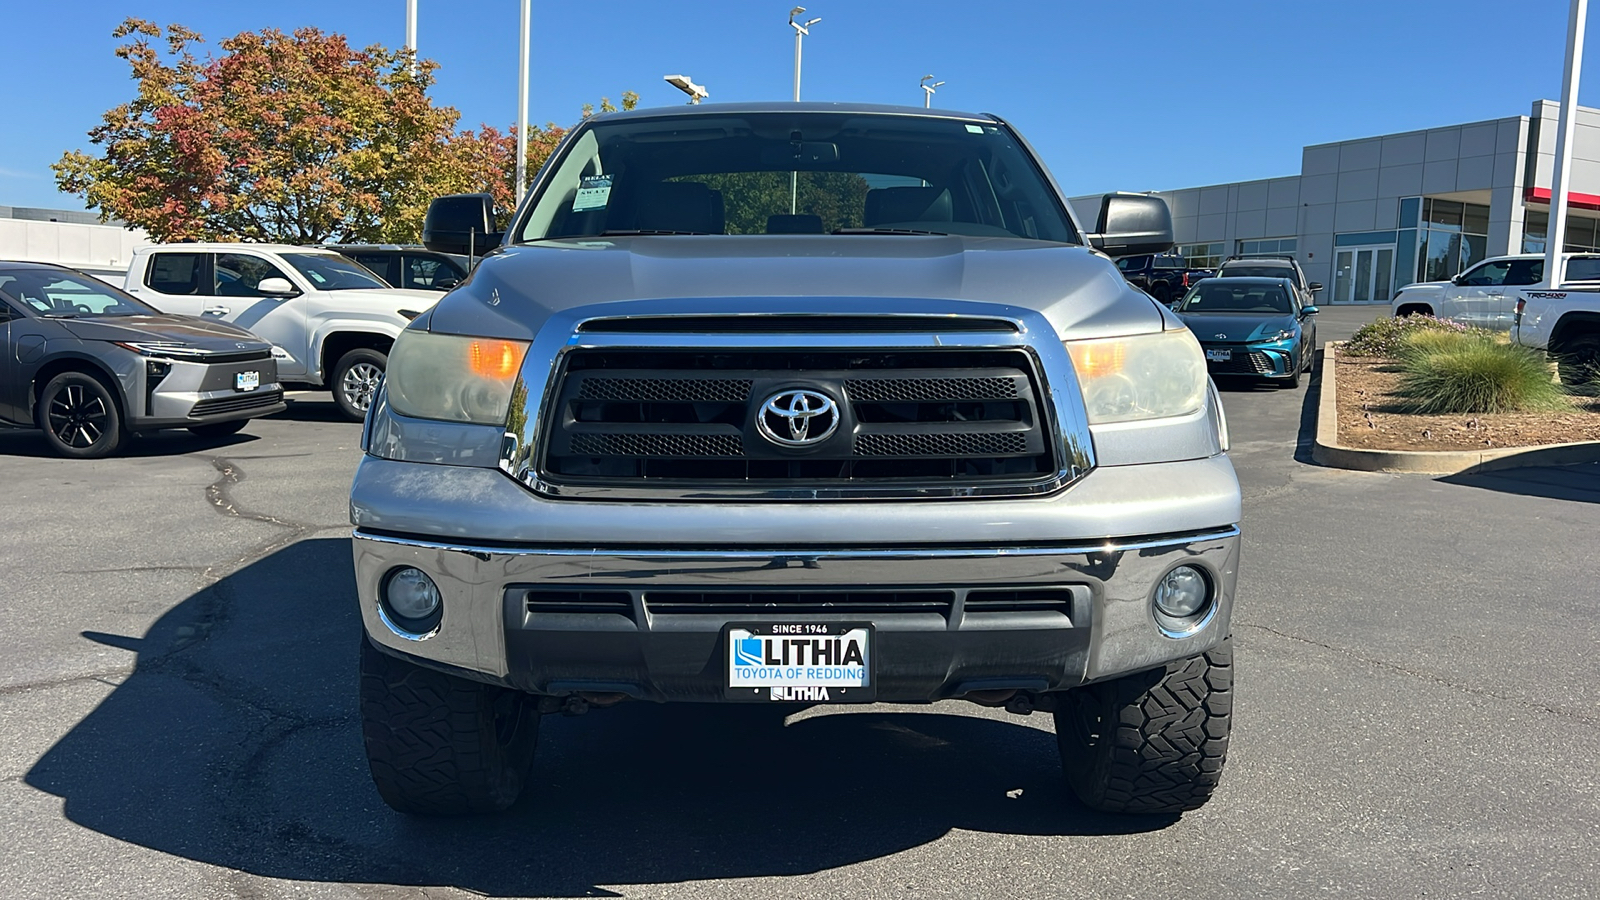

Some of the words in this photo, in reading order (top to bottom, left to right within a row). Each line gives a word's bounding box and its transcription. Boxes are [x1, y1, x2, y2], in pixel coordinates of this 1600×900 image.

[772, 624, 803, 634] SINCE
[805, 624, 828, 634] 1946
[765, 639, 865, 666] LITHIA
[734, 668, 784, 680] TOYOTA
[786, 668, 803, 680] OF
[806, 668, 866, 680] REDDING
